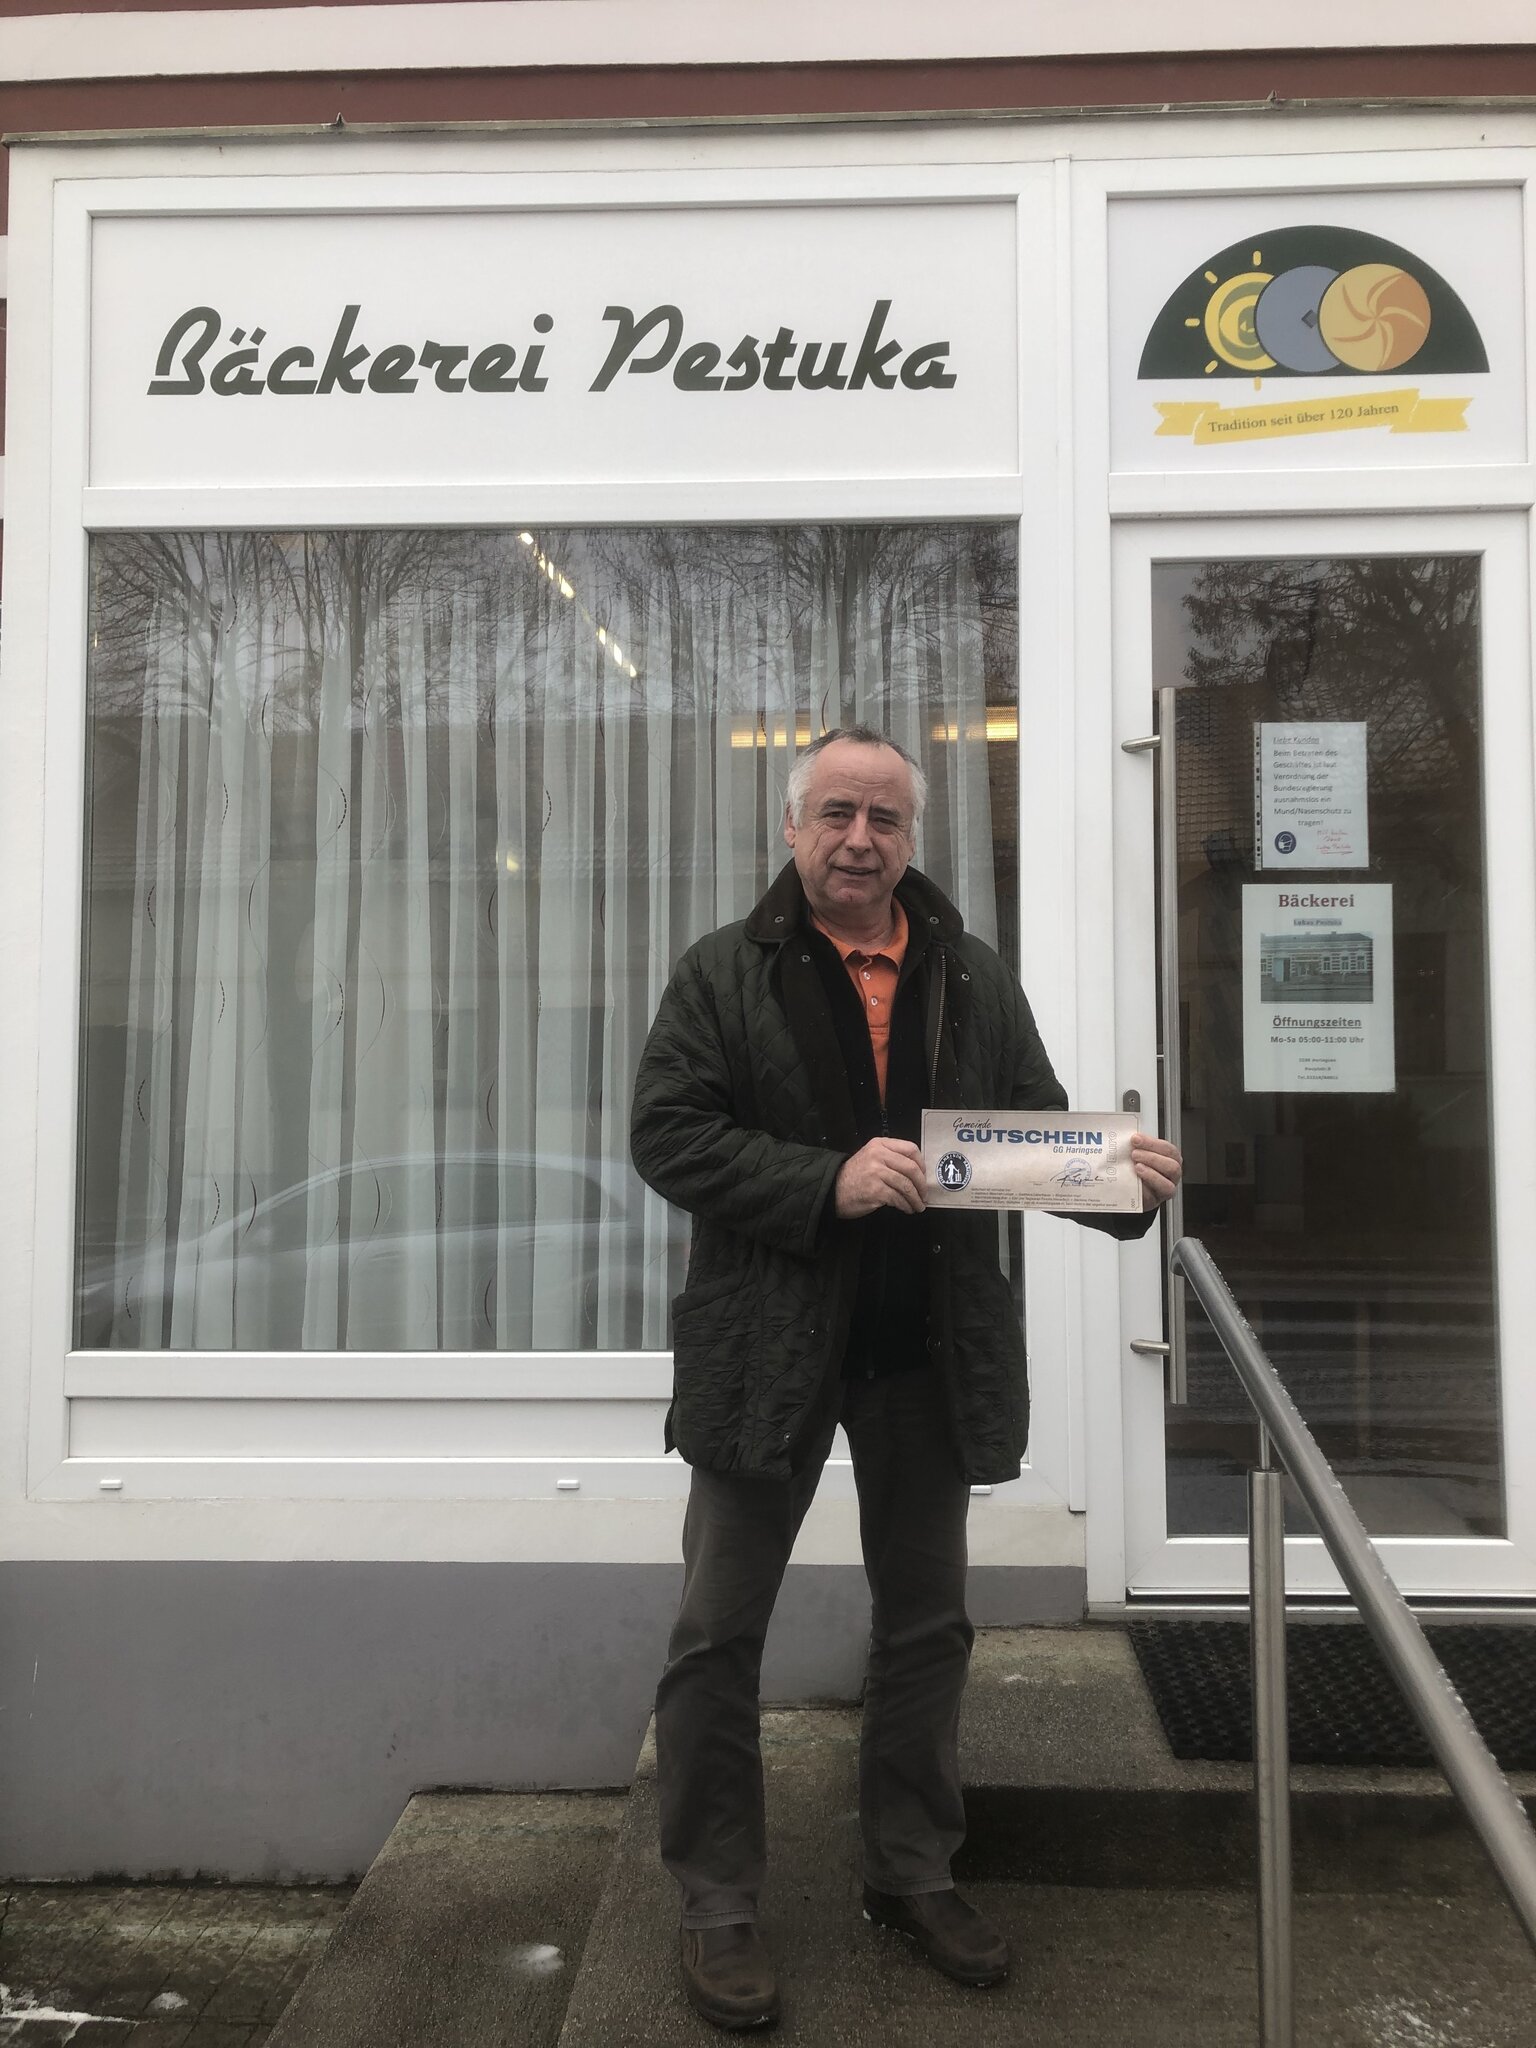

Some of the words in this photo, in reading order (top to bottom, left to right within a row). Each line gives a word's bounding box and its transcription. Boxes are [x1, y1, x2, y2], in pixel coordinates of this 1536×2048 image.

[146, 304, 554, 396] Bäckerei
[588, 299, 958, 392] Pestuka
[1208, 416, 1267, 433] Tradition
[1270, 414, 1293, 426] seit
[1296, 410, 1325, 424] über
[1331, 407, 1354, 421] 120
[1357, 403, 1400, 418] Jahren
[1278, 894, 1355, 908] Bäckerei
[1272, 1015, 1362, 1028] Öffnungszeiten
[952, 1116, 992, 1130] Gemeinde
[956, 1129, 1103, 1145] GUTSCHEIN
[1052, 1145, 1064, 1154] GG
[1066, 1146, 1103, 1155] Haringsee
[1106, 1166, 1117, 1182] 10
